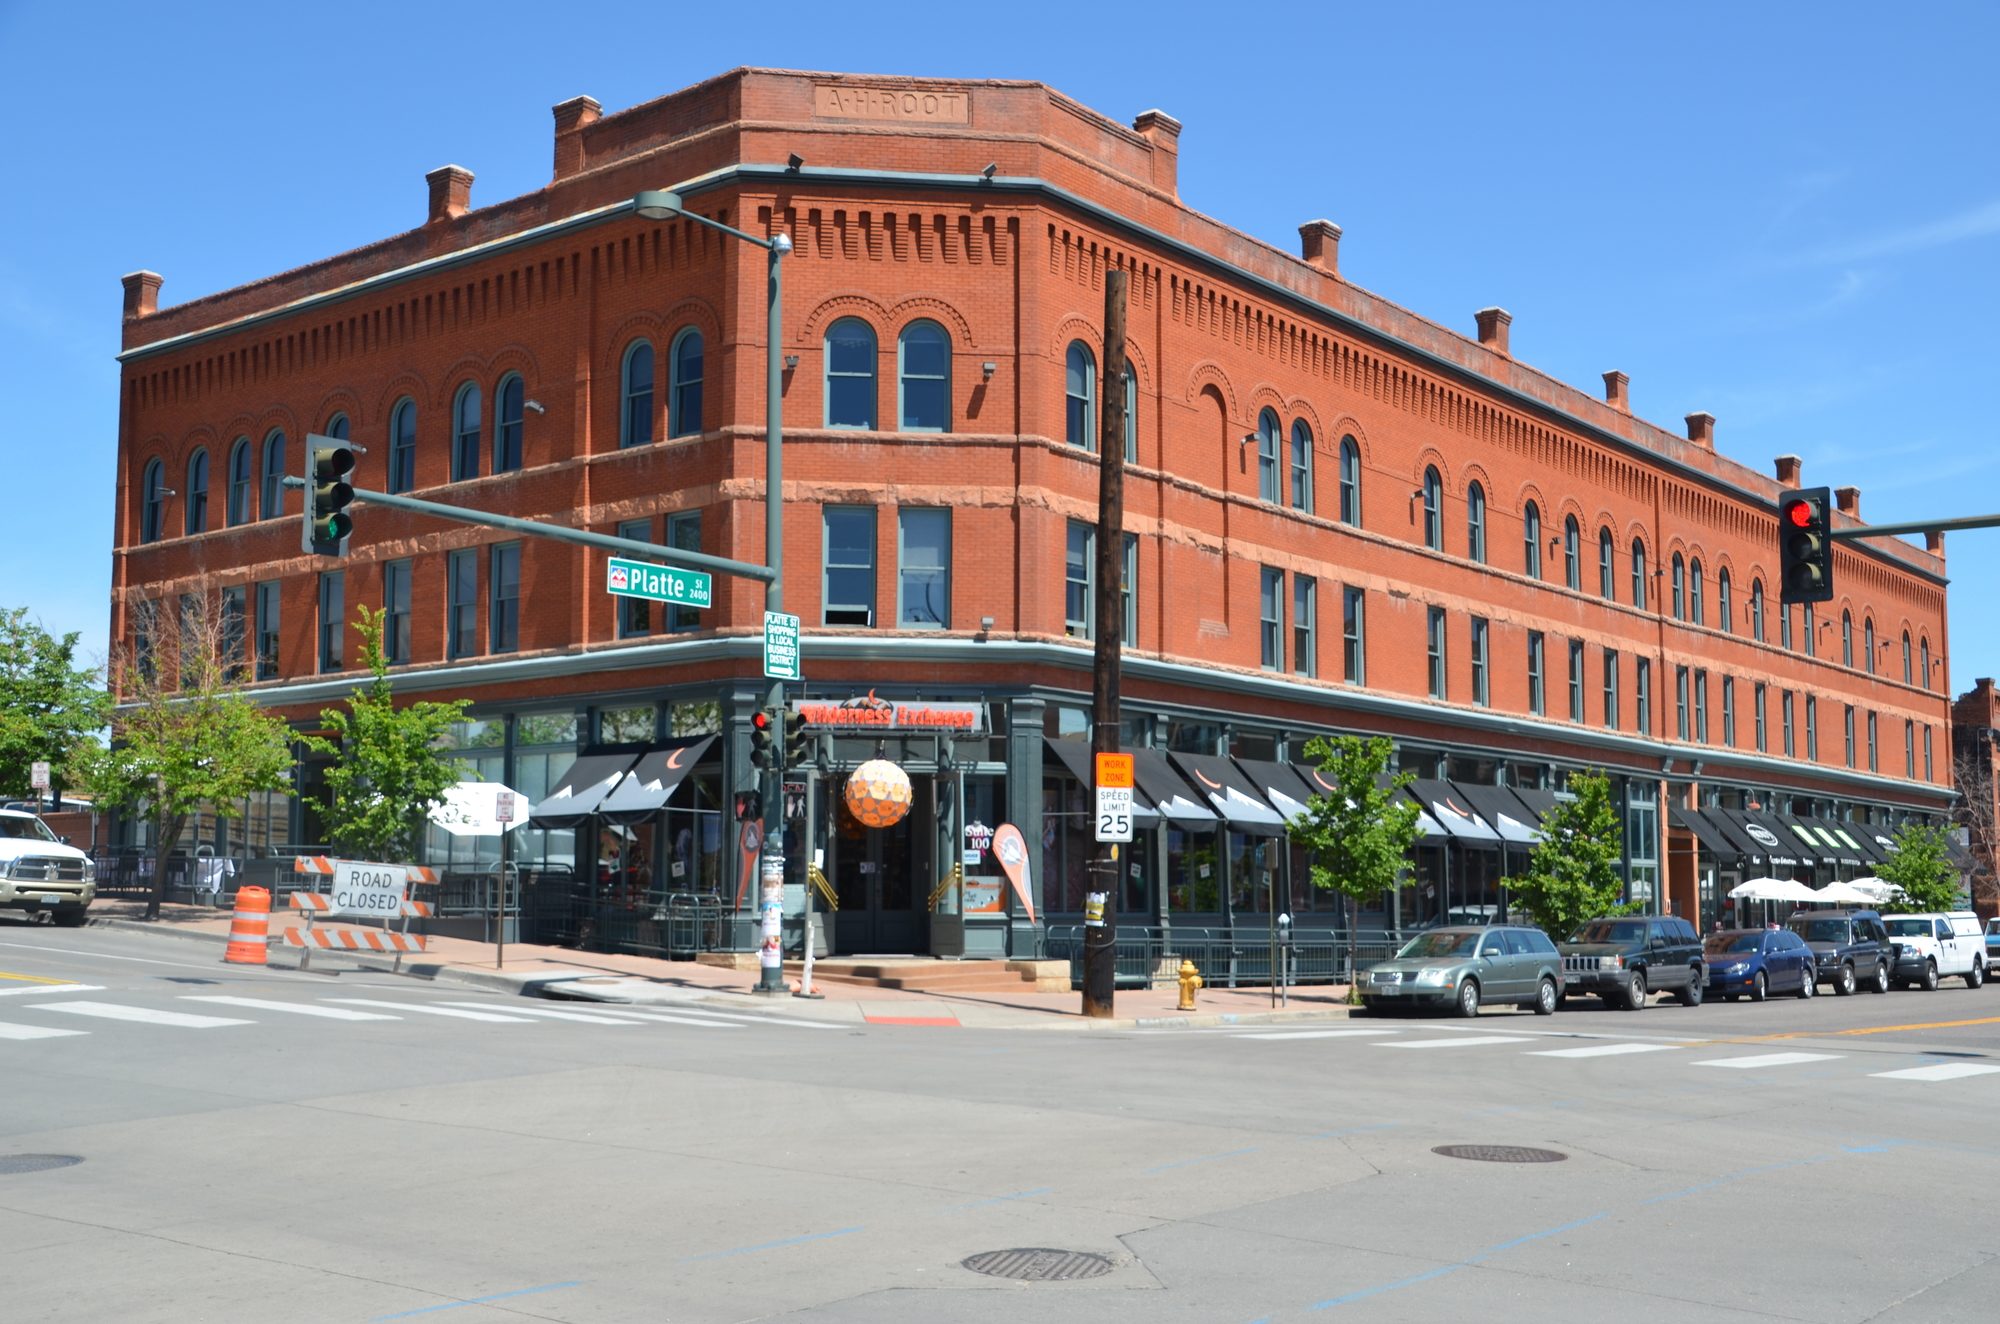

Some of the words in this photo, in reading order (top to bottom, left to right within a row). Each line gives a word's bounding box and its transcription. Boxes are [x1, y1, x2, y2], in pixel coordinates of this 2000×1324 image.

[631, 568, 685, 598] Platte
[695, 578, 703, 589] St
[689, 588, 708, 601] 2400
[766, 614, 788, 626] PLATTE
[789, 617, 797, 628] ST
[767, 624, 796, 638] SHOPPING
[775, 635, 794, 647] LOCAL
[767, 644, 796, 657] BUSINESS
[769, 654, 794, 666] DISTRICT
[800, 704, 893, 725] Wilderness
[897, 706, 975, 728] Exchange
[1104, 760, 1126, 769] WORK
[1105, 772, 1125, 782] ZONE
[1100, 791, 1129, 801] SPEED
[1103, 803, 1126, 811] LIMIT
[1100, 814, 1129, 834] 25
[971, 837, 990, 849] 100
[350, 870, 392, 888] ROAD
[337, 891, 398, 910] CLOSED
